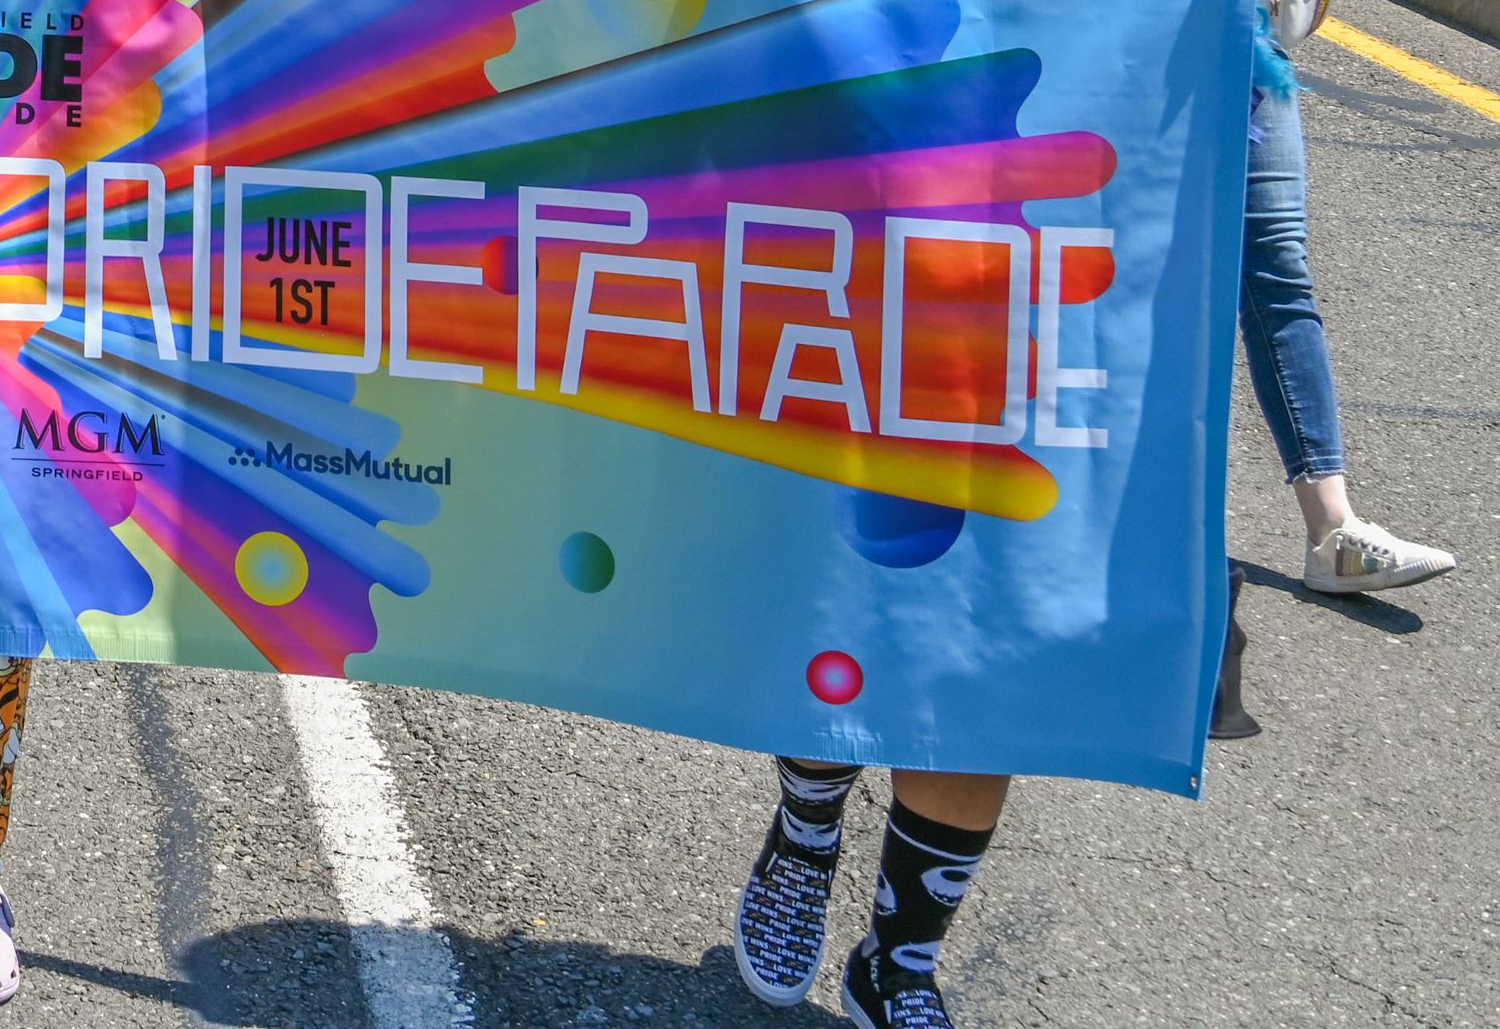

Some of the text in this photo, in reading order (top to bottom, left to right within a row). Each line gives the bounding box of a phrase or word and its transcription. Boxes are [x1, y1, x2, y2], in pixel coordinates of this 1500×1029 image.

[255, 217, 351, 268] JUNE
[269, 277, 336, 326] 1ST
[516, 185, 1115, 449] PARADE
[11, 407, 165, 456] MGM
[31, 467, 144, 482] SPRINGFIELD
[265, 441, 452, 486] MassMutual
